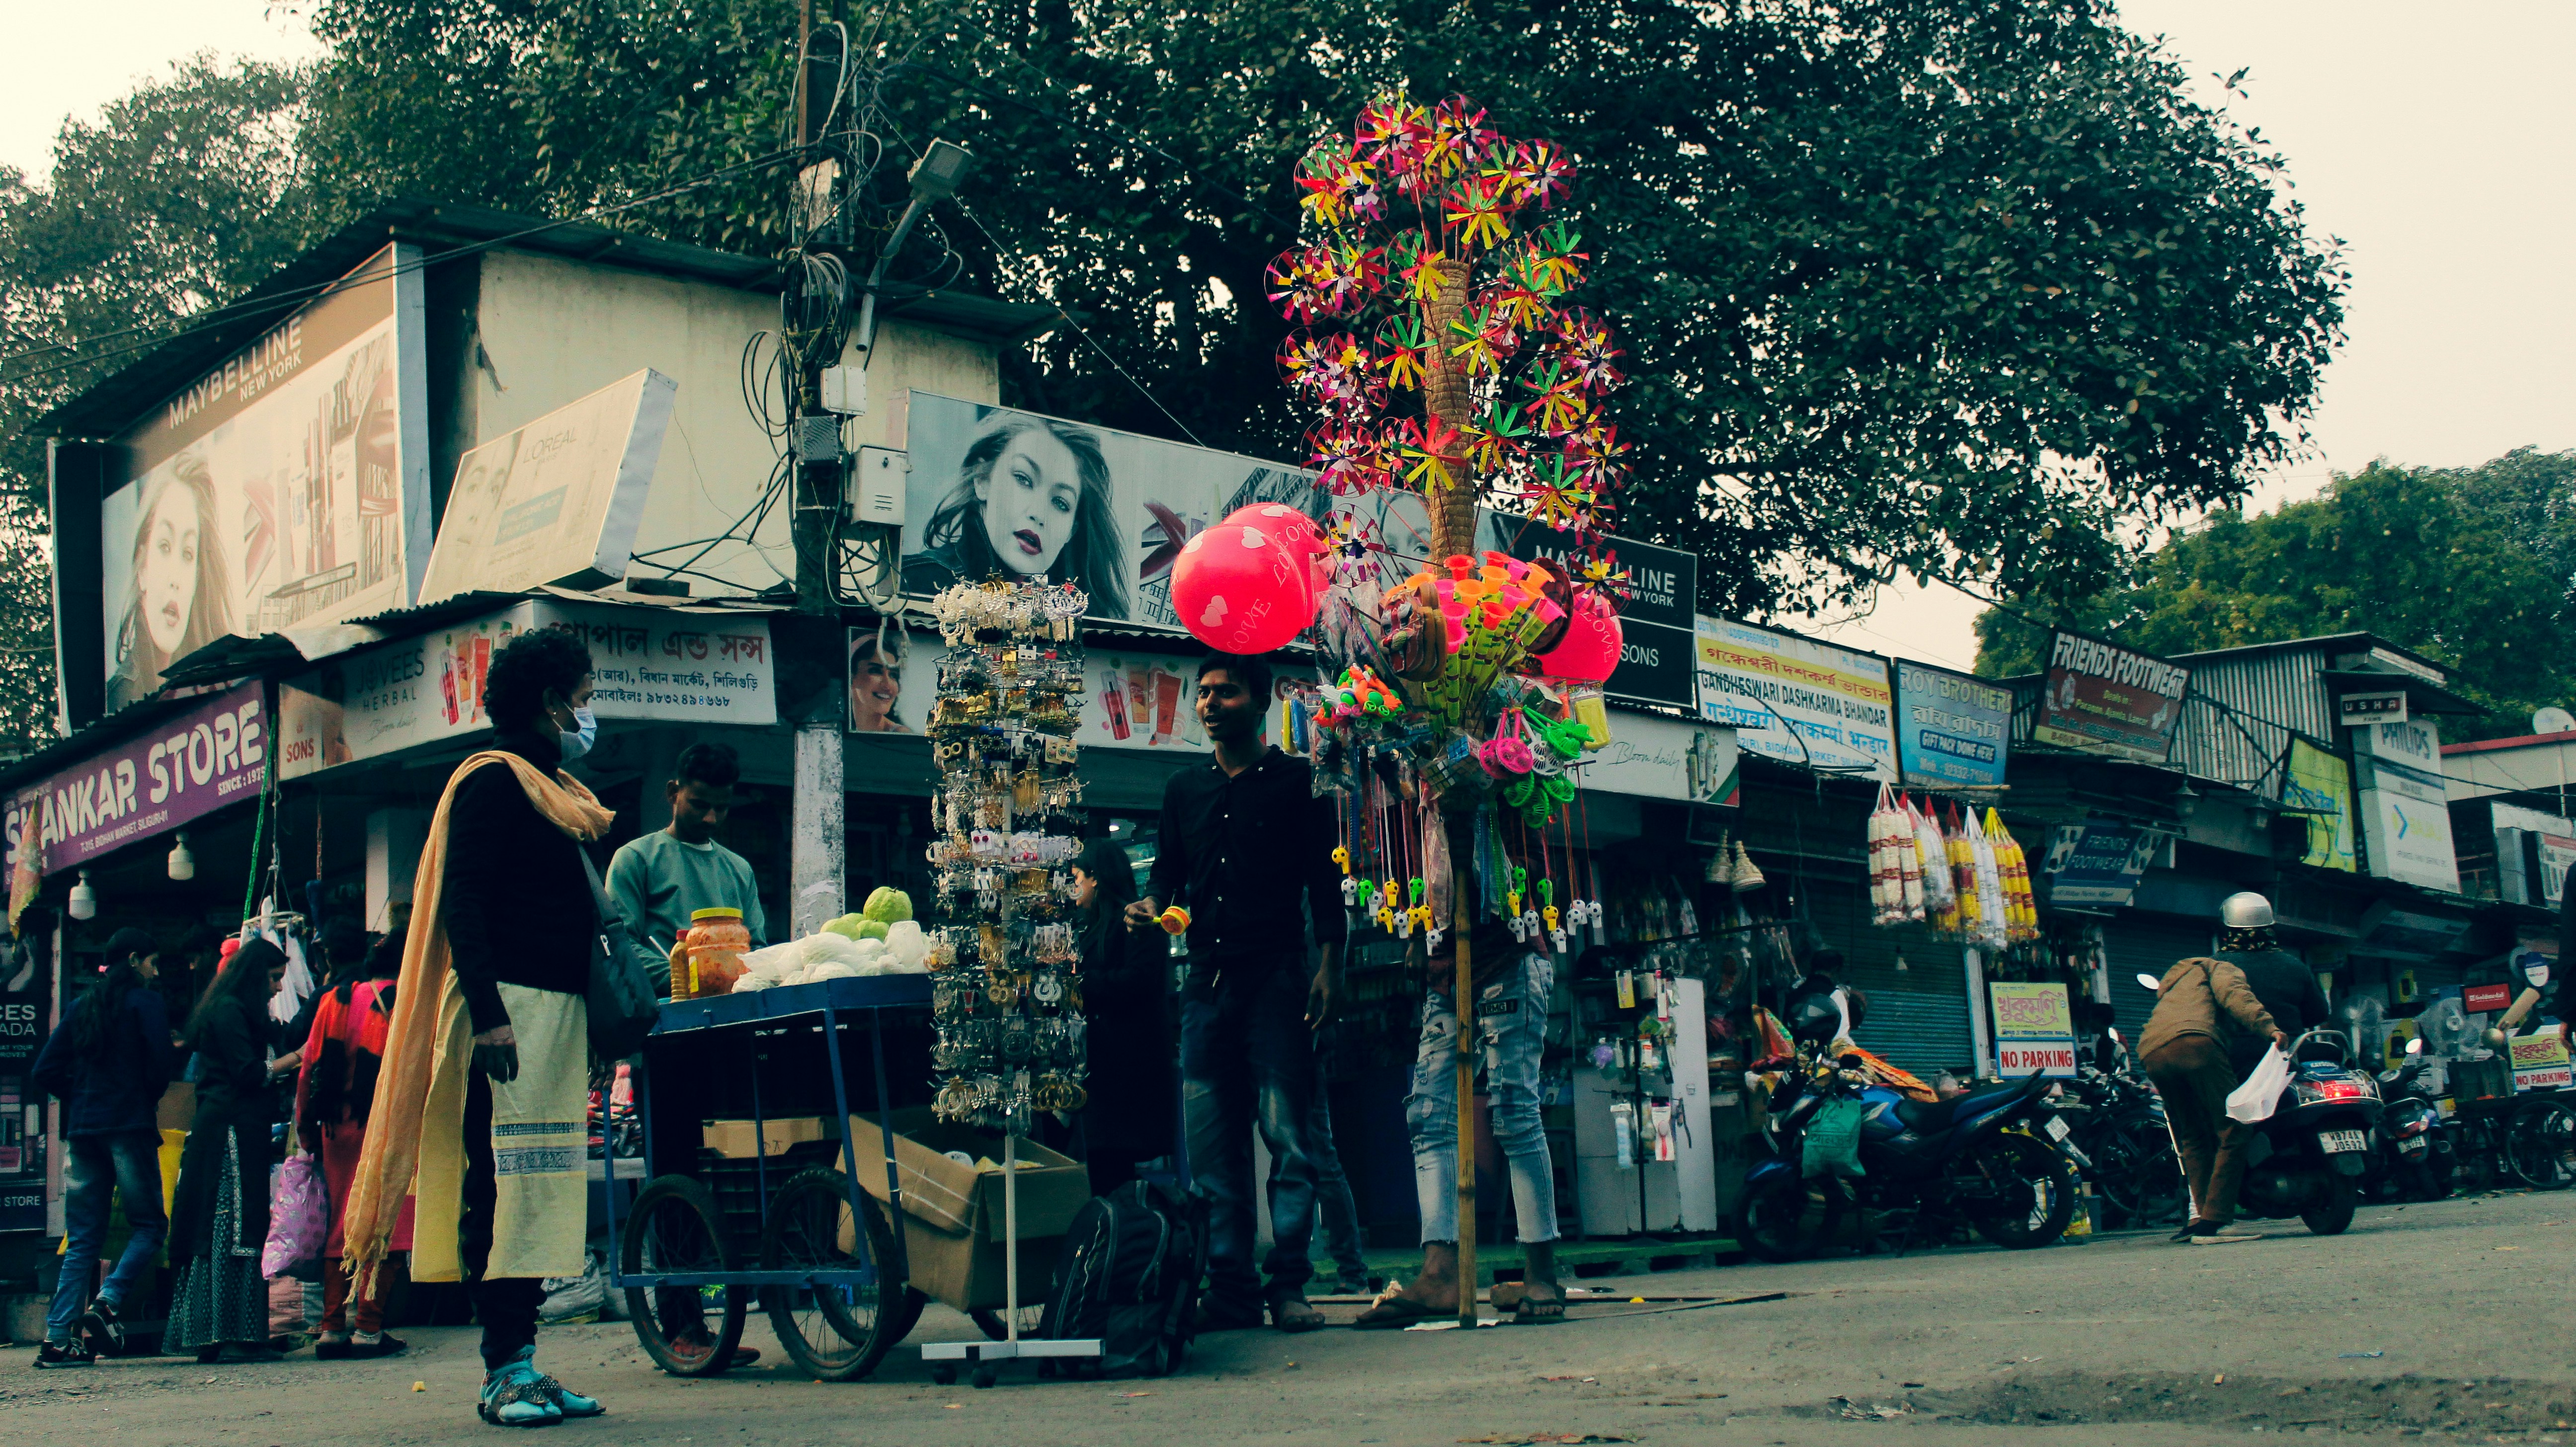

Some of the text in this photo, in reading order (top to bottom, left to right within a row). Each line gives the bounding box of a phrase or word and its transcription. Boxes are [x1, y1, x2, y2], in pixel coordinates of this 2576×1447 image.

[168, 316, 303, 428] MAYBELLINE
[240, 349, 302, 402] NEW YORK
[1642, 590, 1675, 608] YORK
[1226, 598, 1272, 651] LOVE
[1579, 610, 1615, 663] LOVE
[356, 648, 425, 693] JOVEES
[1620, 643, 1659, 667] SONS
[2051, 632, 2189, 702] FRIENDS FOOTWEAR
[639, 666, 668, 685] বিধান
[1899, 667, 2013, 714] ROY BROTHERS
[363, 687, 417, 711] HERBAL
[1701, 669, 1888, 728] GANDHESWARI DASHKARMA BHANDAR
[2345, 700, 2398, 711] USHA
[148, 699, 263, 804] STORE
[286, 737, 315, 763] SONS
[1606, 741, 1681, 781] Bloom daily
[1765, 741, 1801, 756] BIDHAN
[1805, 748, 1838, 765] ARKET,
[2001, 1050, 2072, 1068] NO PARKING
[2515, 1071, 2570, 1086] NO PARKING
[4, 1196, 41, 1207] STORE
